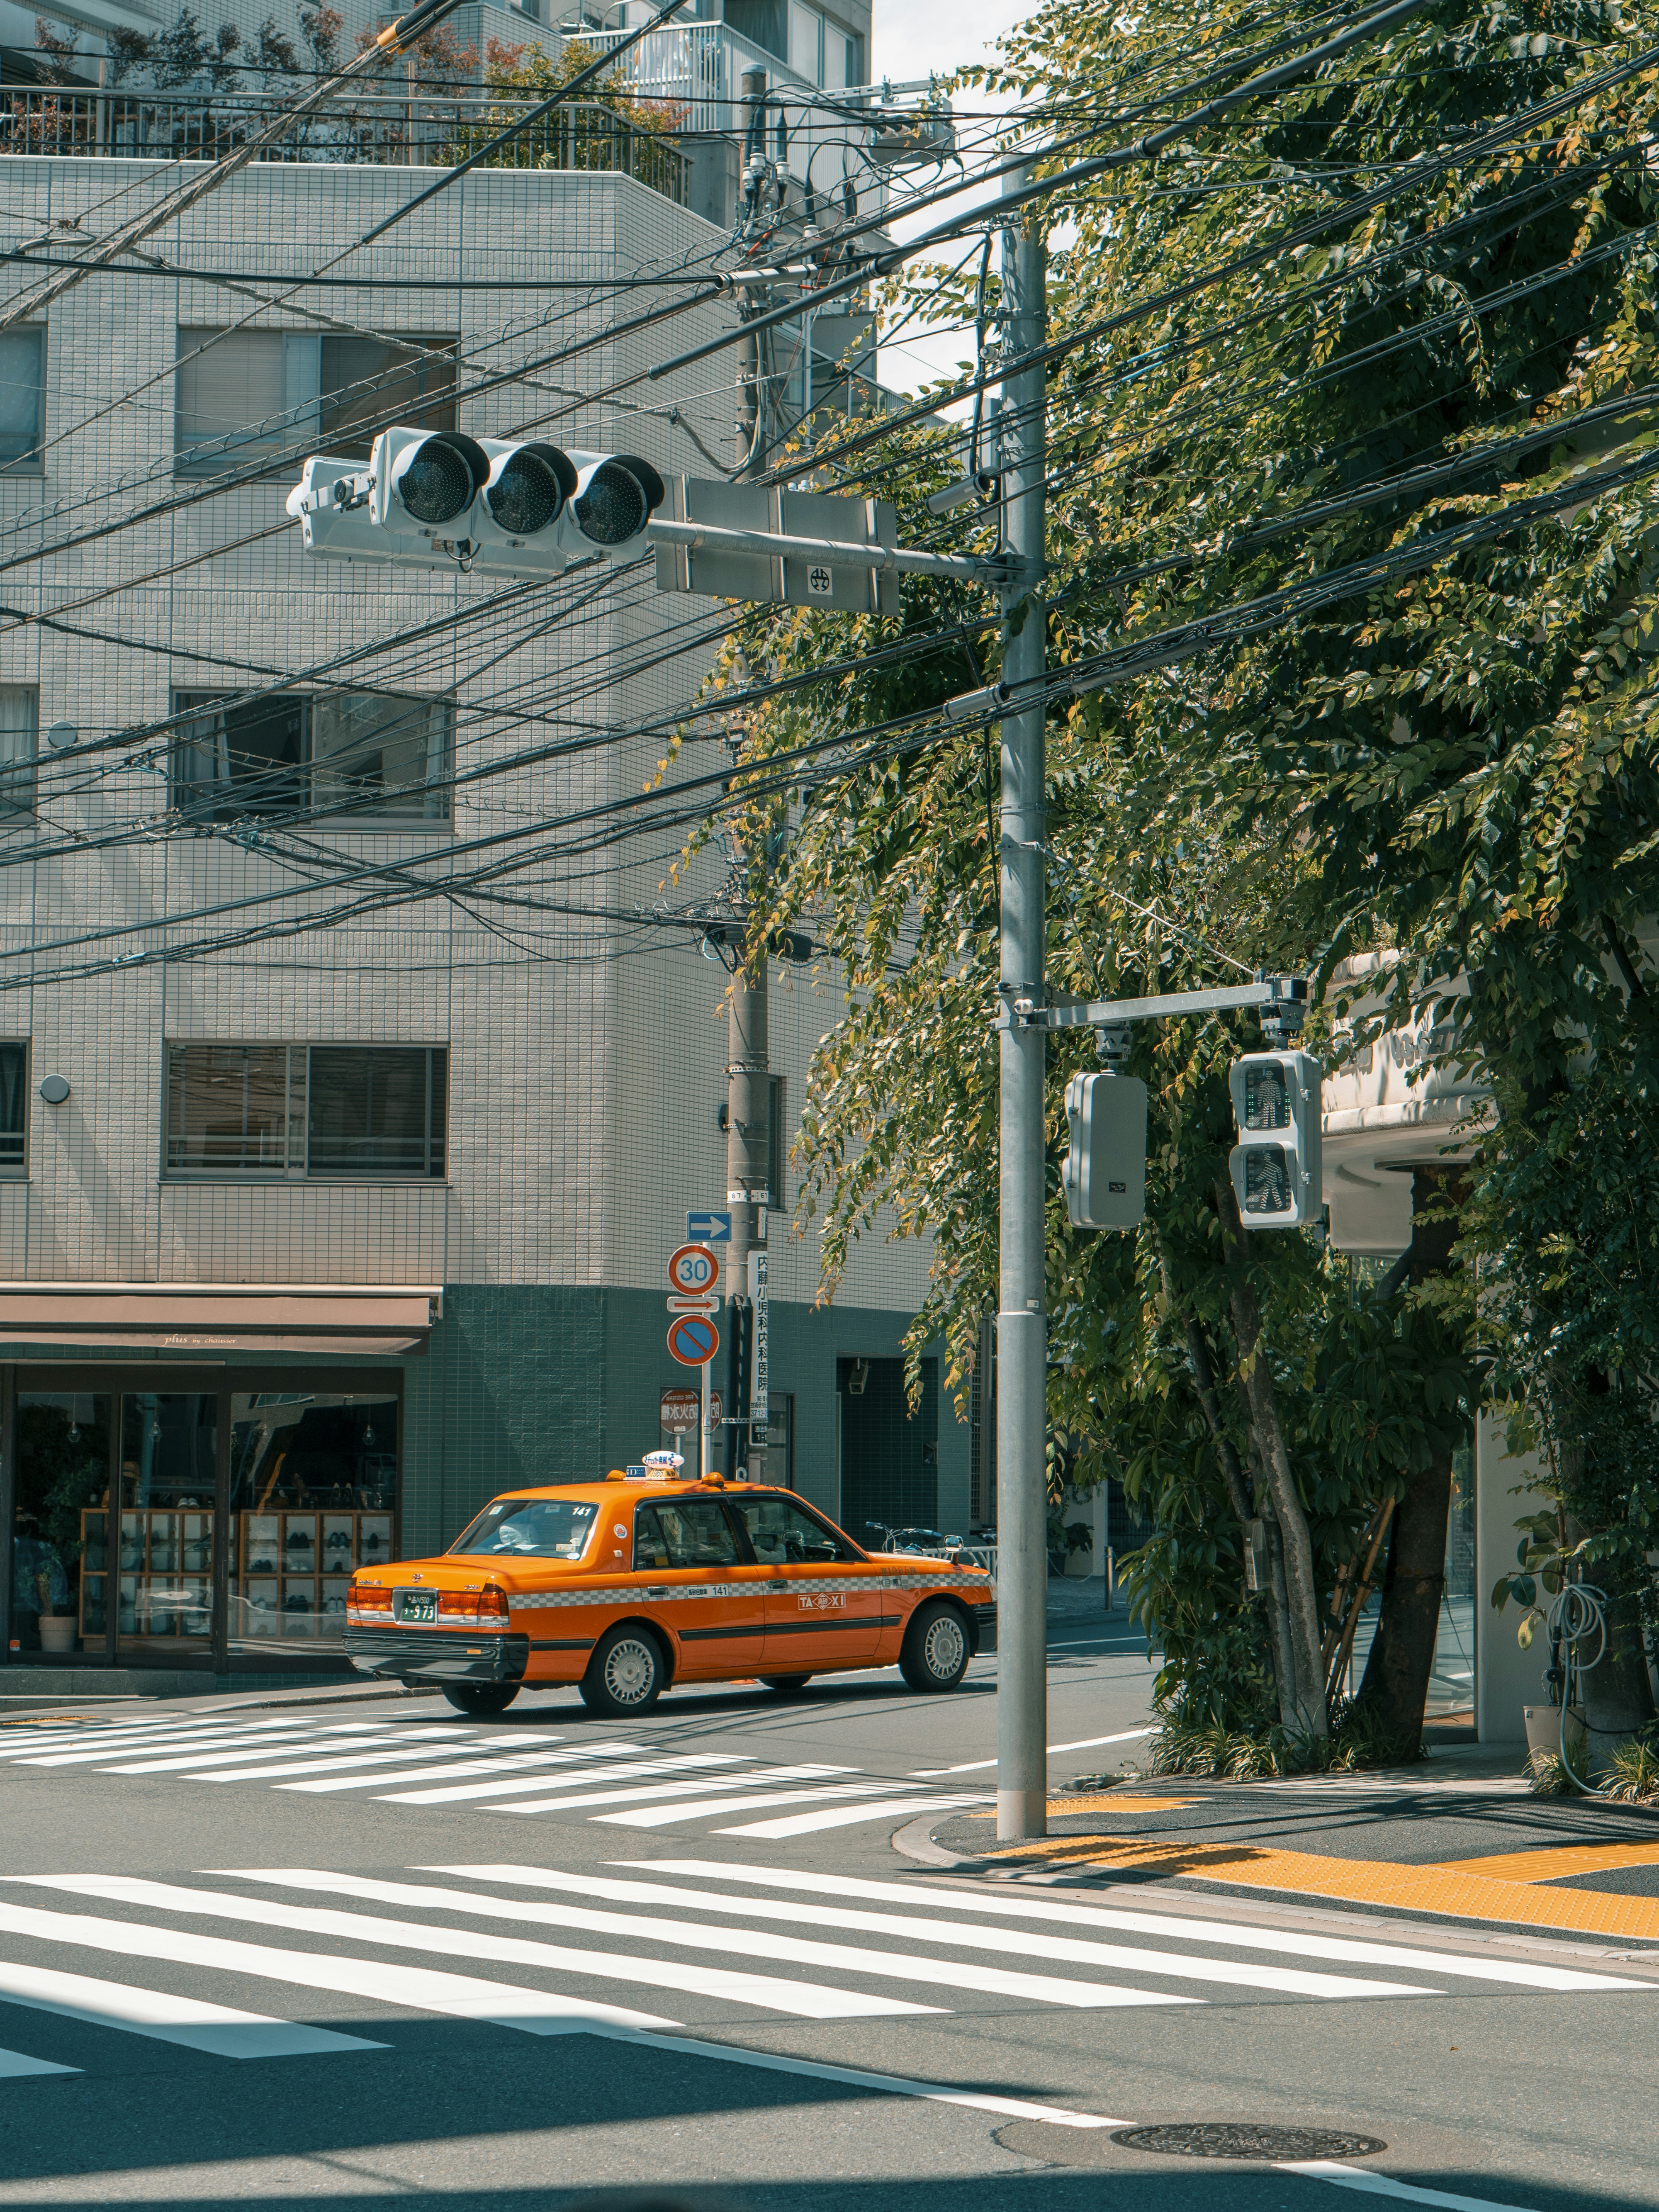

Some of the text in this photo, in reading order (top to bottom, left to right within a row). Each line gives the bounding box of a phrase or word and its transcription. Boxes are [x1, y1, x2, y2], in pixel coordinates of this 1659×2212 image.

[680, 1259, 708, 1281] 30
[161, 1334, 188, 1346] plus
[572, 1506, 591, 1516] 141
[713, 1586, 727, 1595] 141
